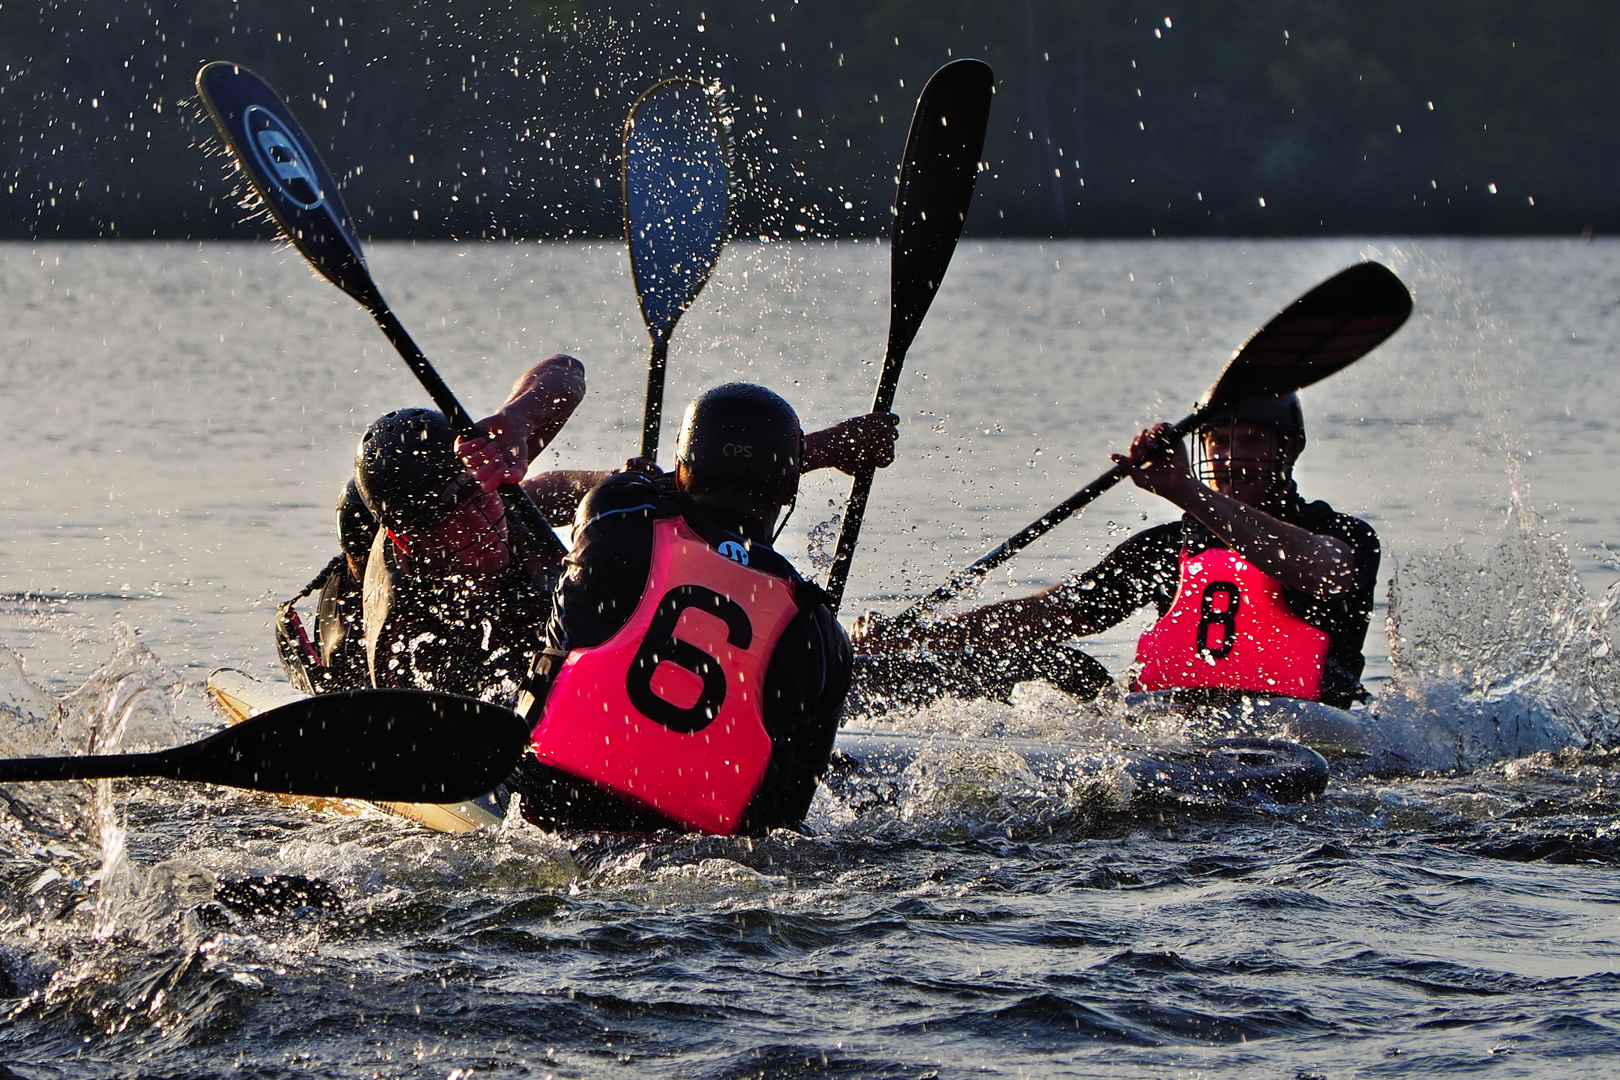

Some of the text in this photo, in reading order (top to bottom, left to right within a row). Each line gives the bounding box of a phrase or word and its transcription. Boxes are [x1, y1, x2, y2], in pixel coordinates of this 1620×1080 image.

[722, 443, 753, 458] CPS
[626, 584, 753, 734] 6
[1196, 580, 1240, 659] 8
